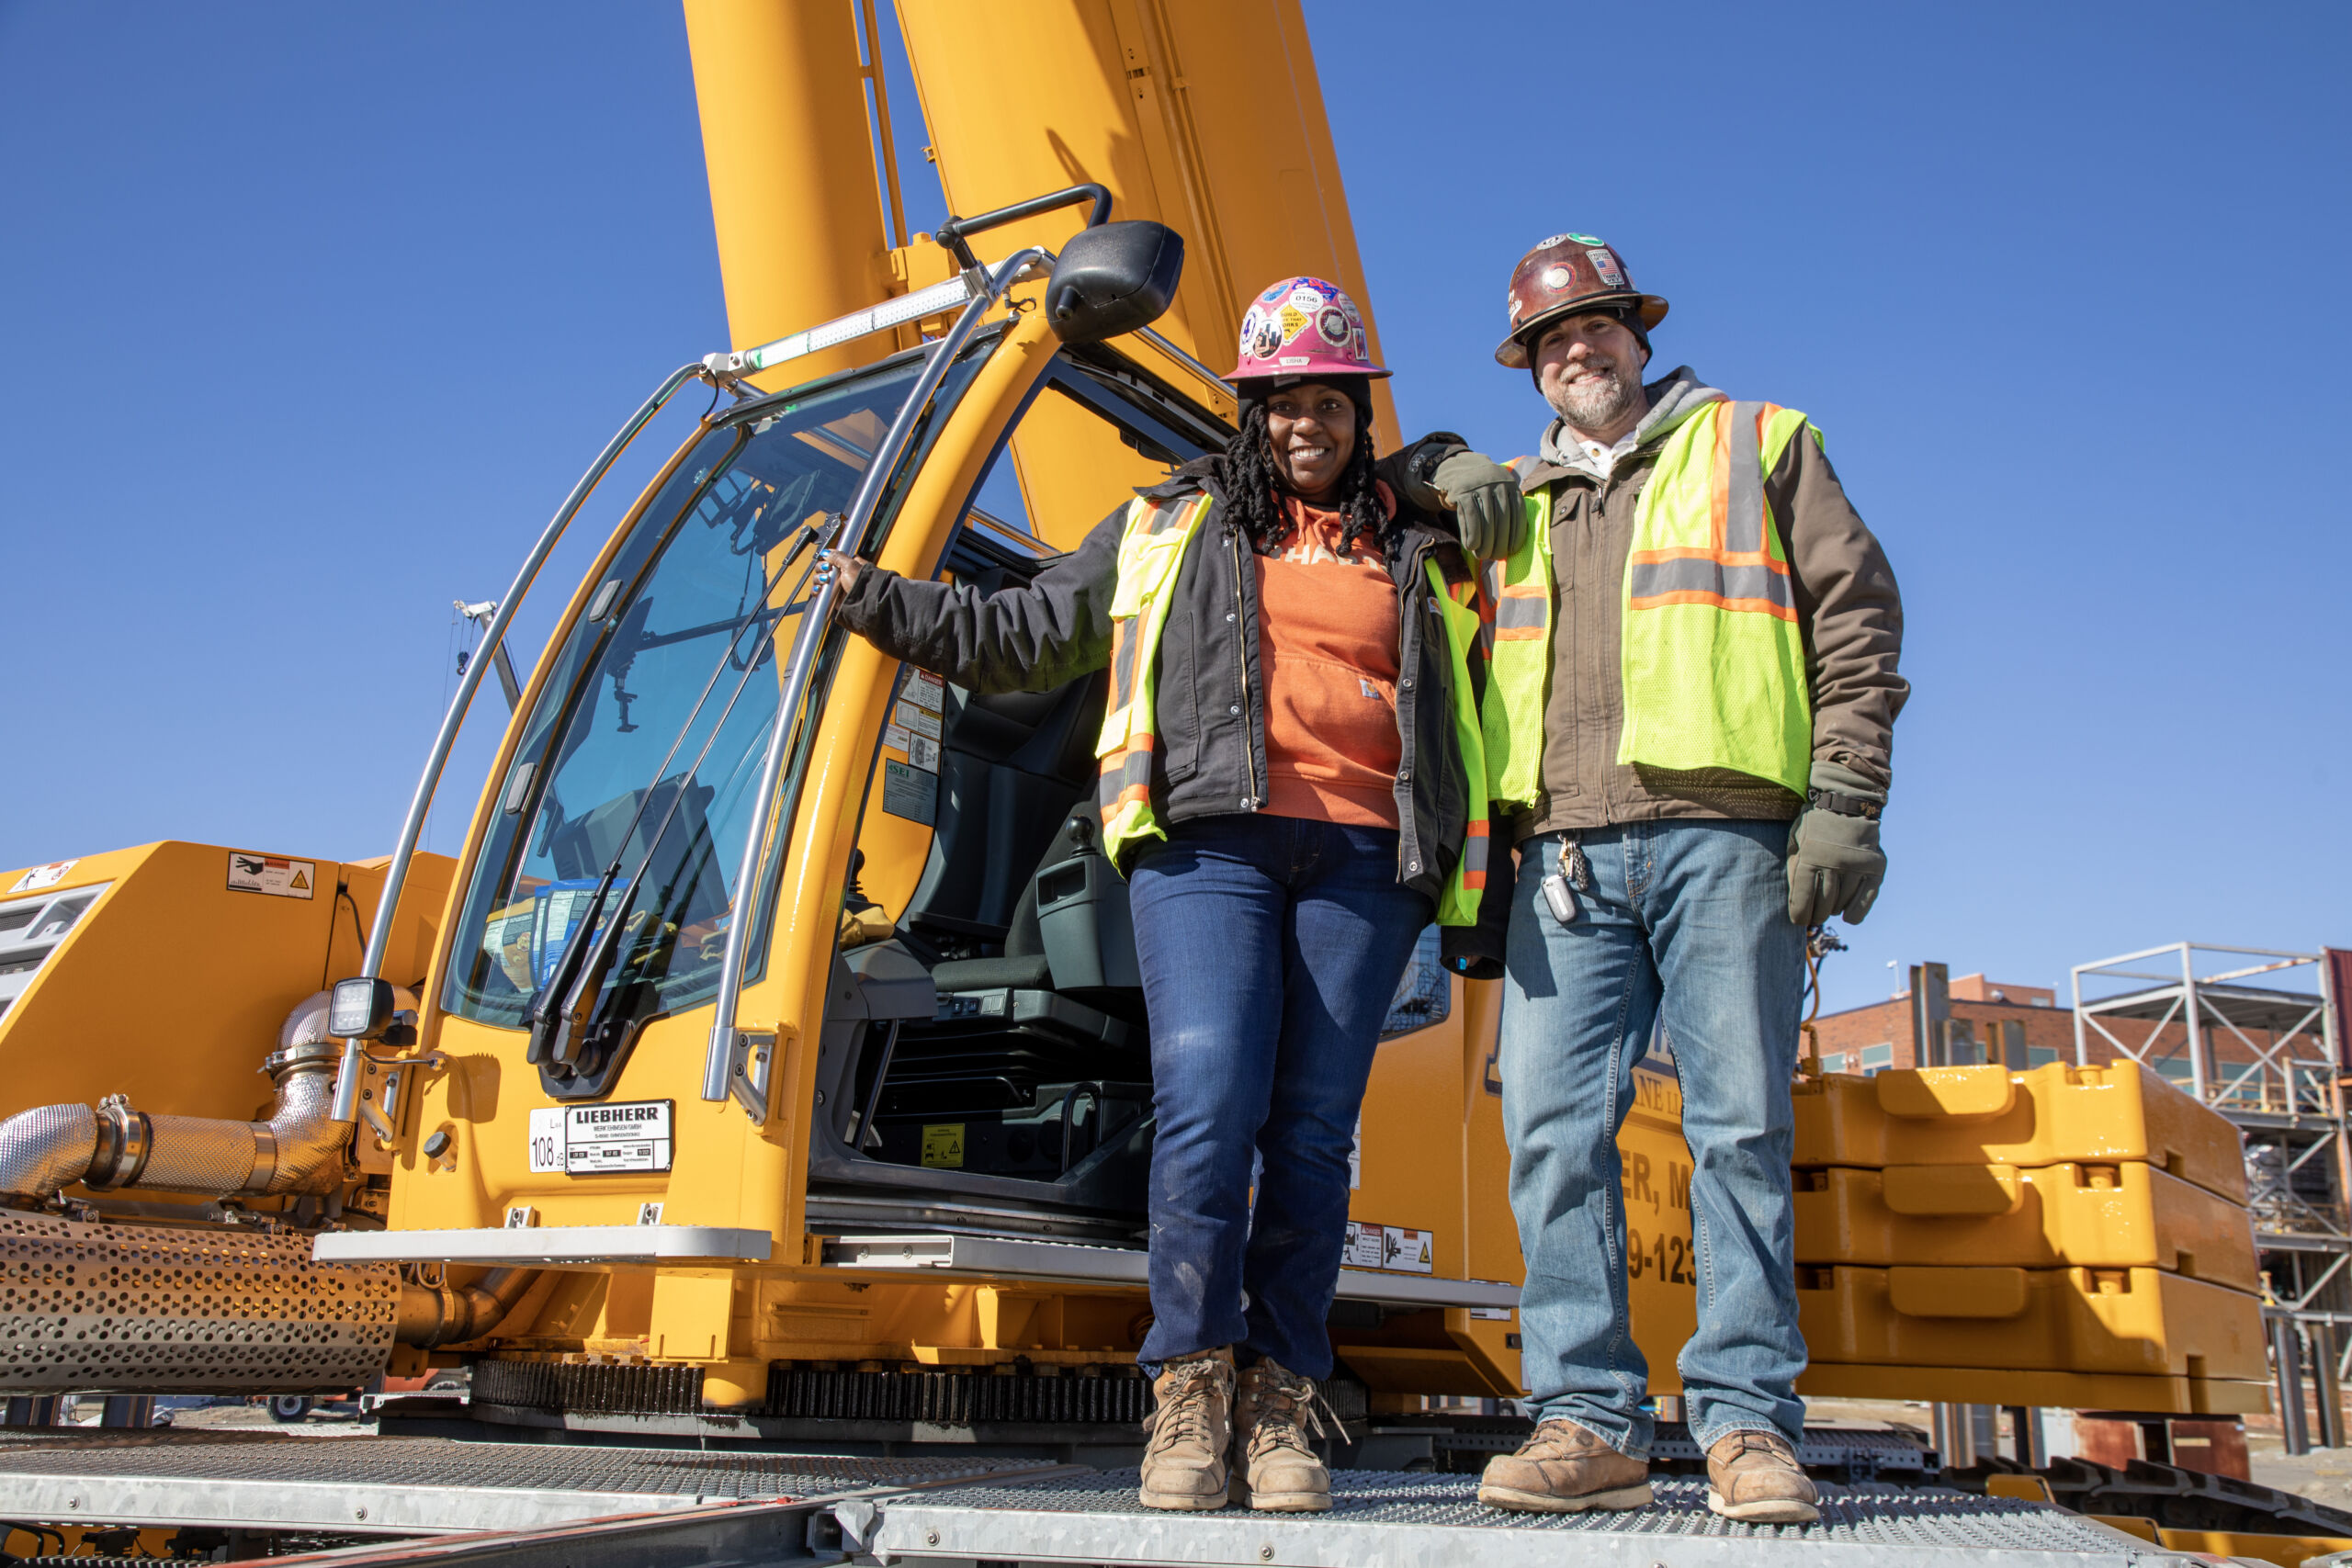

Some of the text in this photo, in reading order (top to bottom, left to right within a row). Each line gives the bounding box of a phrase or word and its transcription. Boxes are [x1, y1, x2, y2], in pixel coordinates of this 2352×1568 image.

[1295, 295, 1317, 303] 0156
[1634, 1075, 1663, 1111] NE
[576, 1107, 659, 1124] LIEBHERR
[532, 1136, 554, 1168] 108
